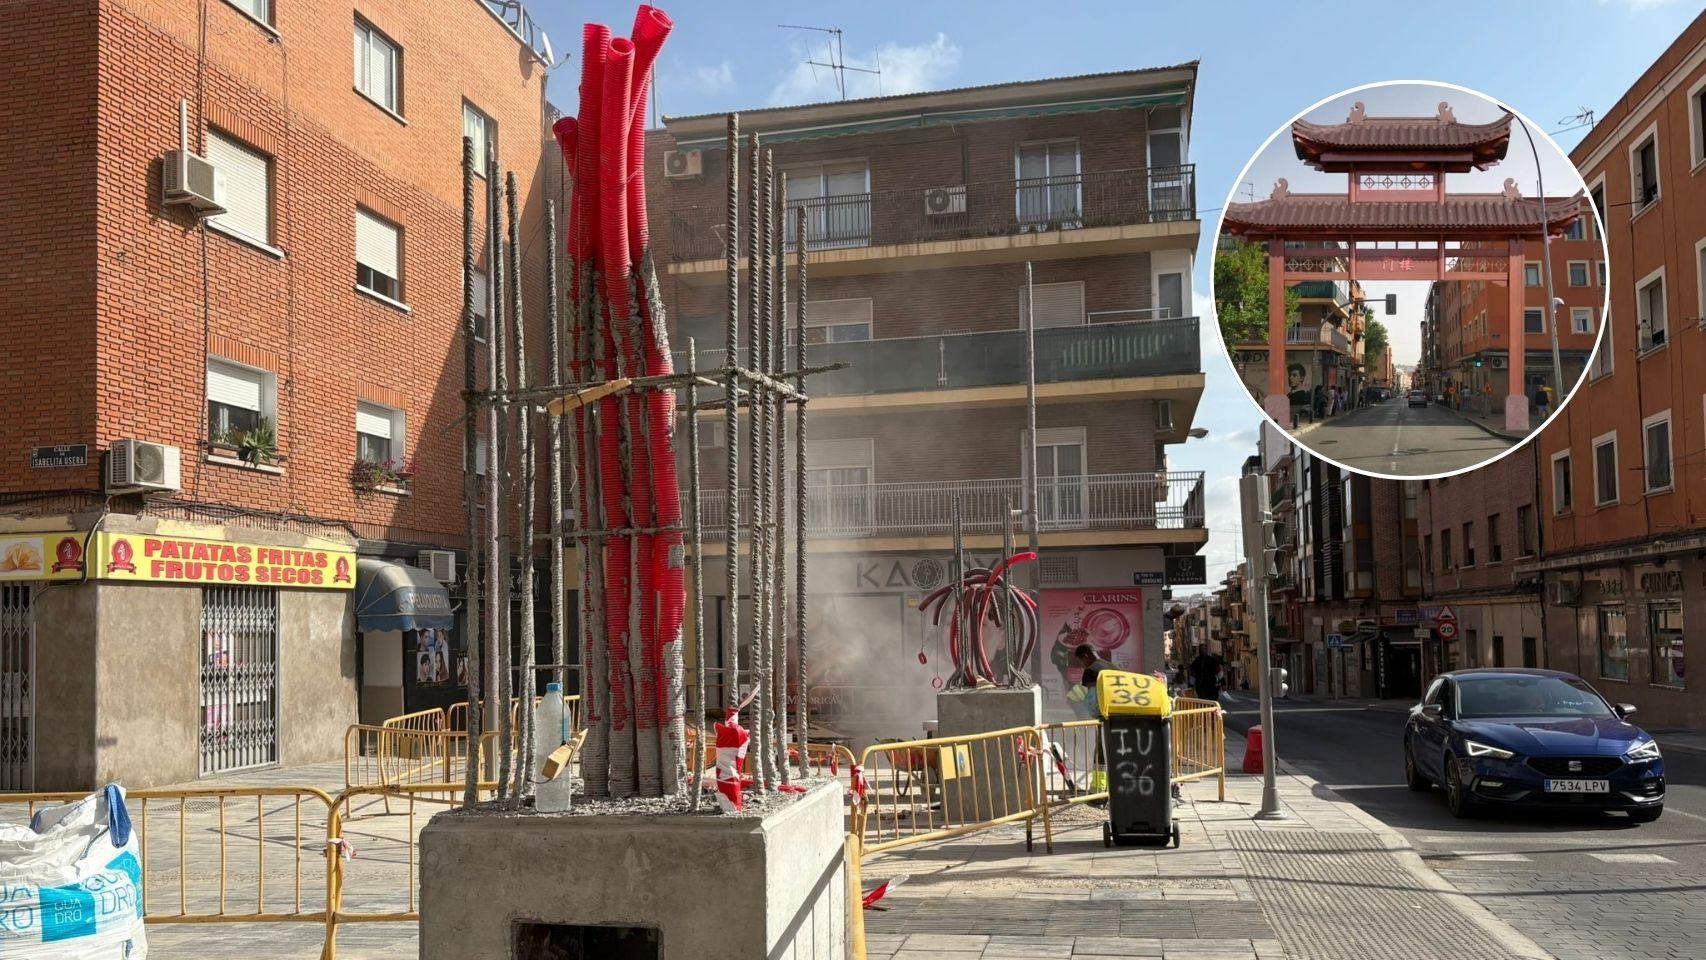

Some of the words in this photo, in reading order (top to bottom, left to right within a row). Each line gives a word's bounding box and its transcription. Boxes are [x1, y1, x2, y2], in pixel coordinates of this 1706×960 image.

[32, 458, 63, 467] ISABELITA
[64, 456, 84, 464] USERA
[144, 538, 252, 563] PATATAS
[256, 548, 328, 568] FRITAS
[150, 560, 250, 582] FRUTOS
[255, 566, 324, 584] SECOS
[1083, 594, 1137, 603] CLARINS
[1111, 689, 1151, 706] 36
[1116, 761, 1154, 795] 36
[1552, 781, 1581, 791] 7534
[1585, 781, 1606, 791] LPV
[54, 909, 82, 925] DRO
